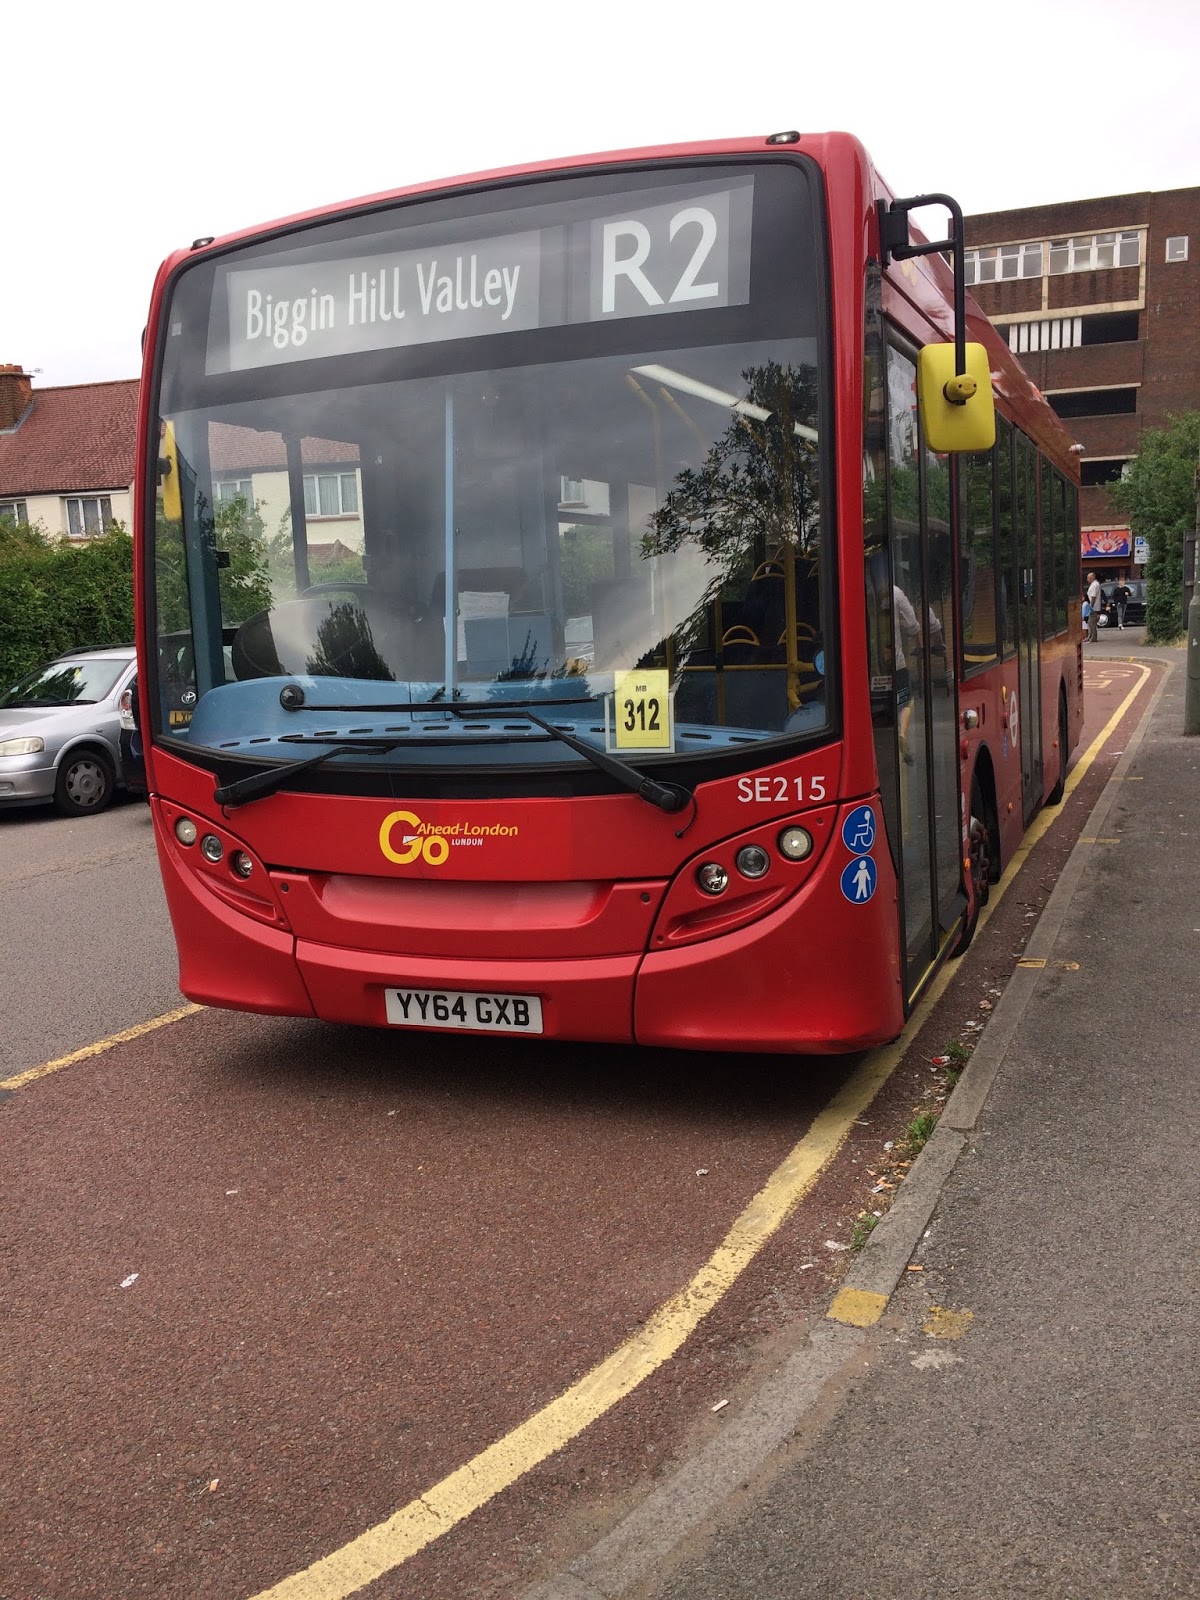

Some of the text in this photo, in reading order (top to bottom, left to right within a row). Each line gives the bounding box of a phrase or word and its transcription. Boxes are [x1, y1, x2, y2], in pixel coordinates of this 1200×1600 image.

[602, 207, 719, 313] R2
[247, 255, 520, 349] Biggin Hill Valley
[624, 698, 660, 732] 312
[737, 775, 826, 803] SE215
[379, 810, 450, 866] Go
[451, 837, 484, 846] LONDON
[396, 992, 530, 1027] YY64 GXB
